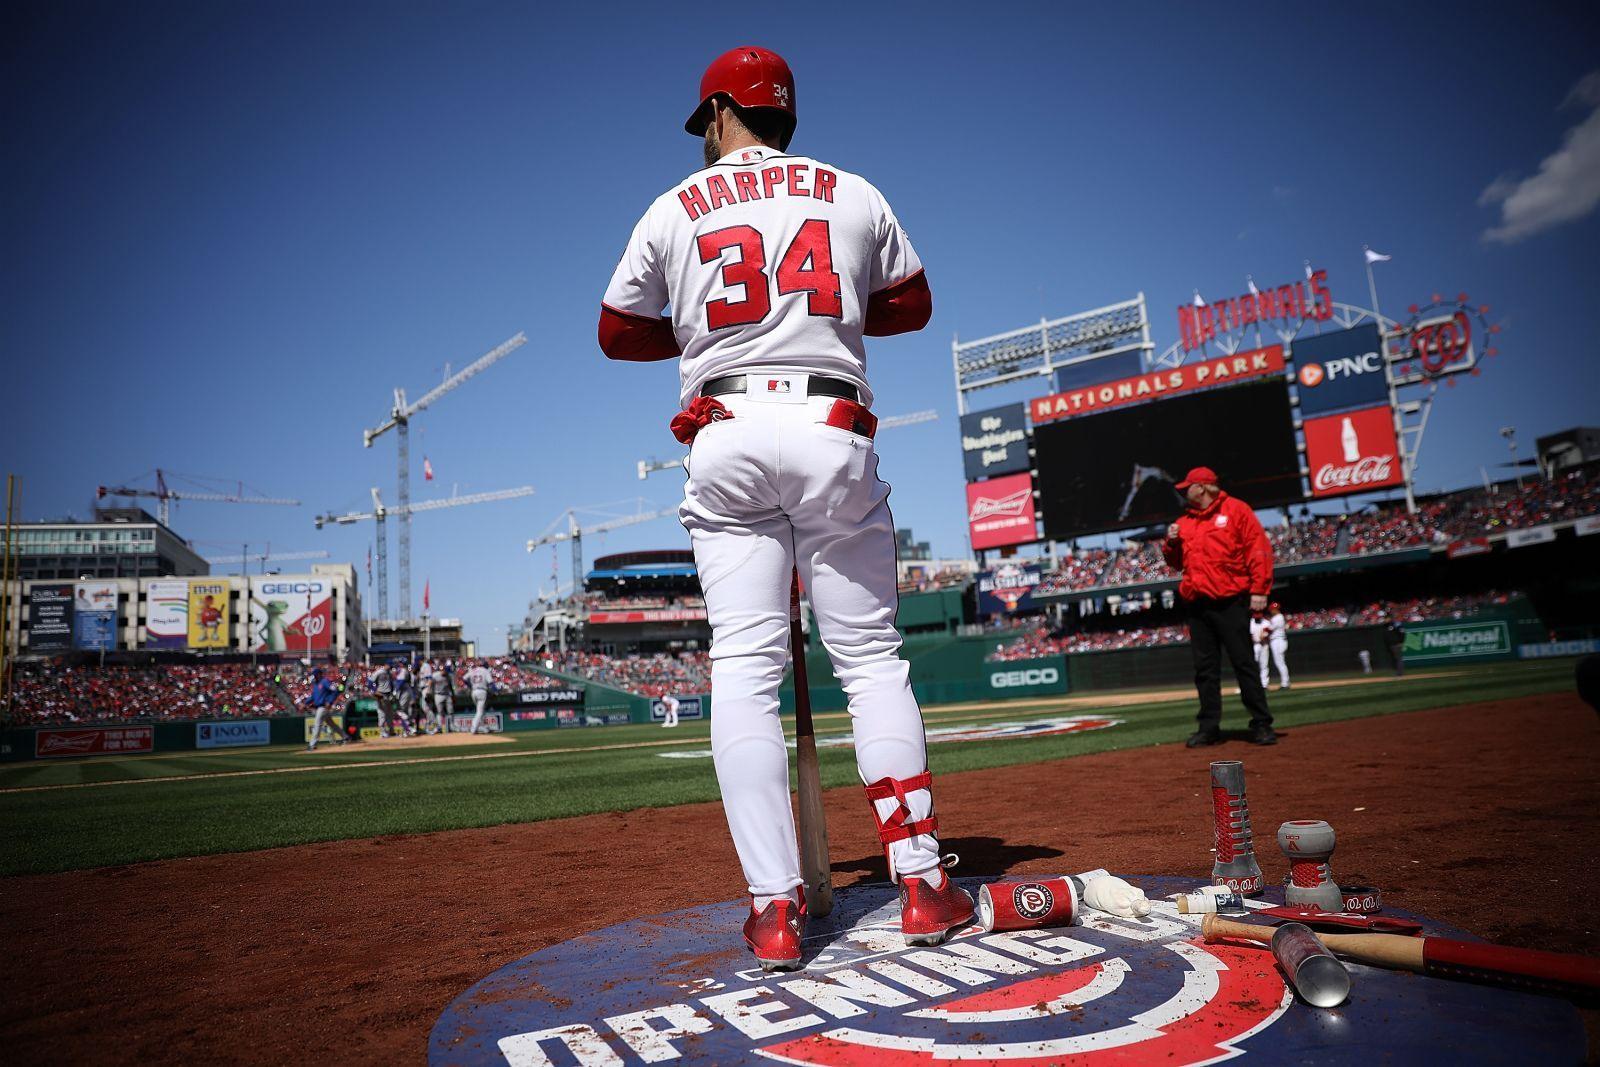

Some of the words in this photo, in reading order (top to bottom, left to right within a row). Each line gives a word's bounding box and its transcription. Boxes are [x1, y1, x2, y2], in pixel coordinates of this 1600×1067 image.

[774, 84, 788, 99] 34
[678, 164, 837, 221] HARPER
[696, 218, 843, 332] 34
[1177, 270, 1332, 352] NATIONALS
[1325, 352, 1381, 380] PNC
[1038, 372, 1184, 417] NATIONALS
[1197, 353, 1269, 382] PARK
[262, 583, 322, 594] GEICO
[1423, 626, 1500, 648] National
[991, 668, 1059, 688] GEICO
[214, 725, 259, 738] INOVA
[497, 929, 1106, 1067] OPENING
